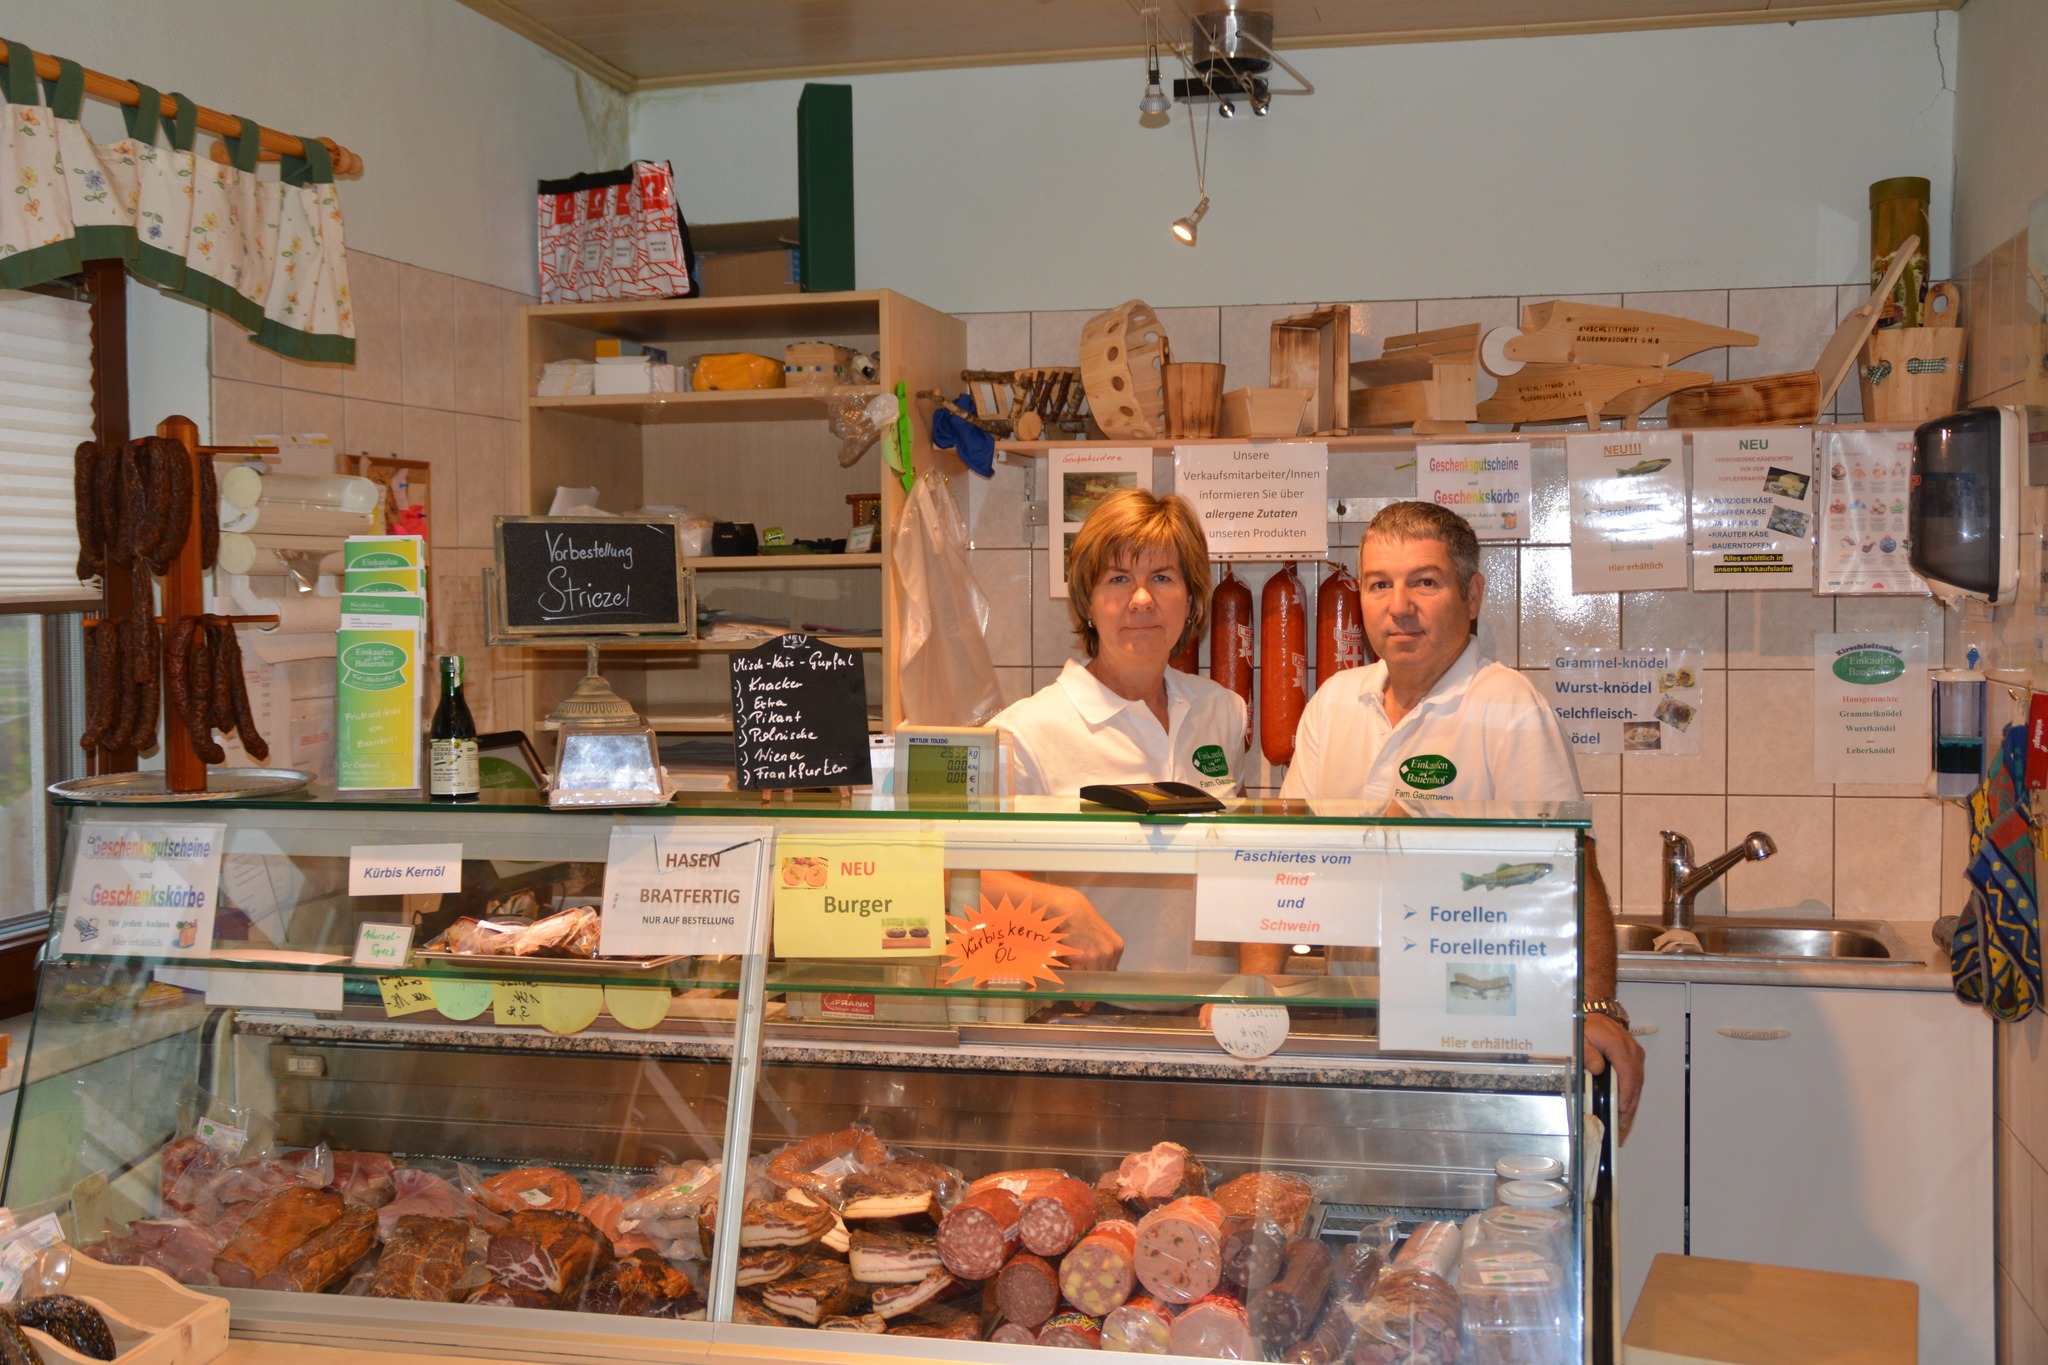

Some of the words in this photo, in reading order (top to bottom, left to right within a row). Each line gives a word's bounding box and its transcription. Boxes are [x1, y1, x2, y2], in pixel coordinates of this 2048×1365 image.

[1603, 443, 1642, 455] NEU!!!
[1739, 439, 1769, 450] NEU
[1233, 451, 1270, 460] Unsere
[1429, 456, 1519, 475] Geschenksgutscheine
[1183, 468, 1320, 481] Verkaufsmitarbeiter/Innen
[1199, 490, 1260, 500] informieren
[1262, 489, 1278, 499] Sie
[1280, 489, 1304, 499] über
[1434, 488, 1520, 505] Geschenkskörbe
[1205, 509, 1254, 520] allergene
[1257, 509, 1298, 519] Zutaten
[1209, 529, 1250, 538] unseren
[1253, 528, 1307, 538] Produkten
[545, 530, 633, 569] Vorbestellung
[1609, 564, 1625, 572] Hier
[1626, 562, 1664, 571] erhältlich
[538, 566, 630, 613] Striezel
[356, 648, 394, 656] Einkaufen
[355, 660, 395, 668] Bauernhof
[1555, 657, 1668, 669] Grammel-knödel
[1849, 656, 1895, 665] Einkaufen
[749, 677, 803, 692] Knacker
[1555, 681, 1652, 694] Wurst-knödel
[749, 710, 801, 724] Pikant
[1555, 707, 1638, 719] Selchfleisch-
[1839, 710, 1902, 718] Grammelknödel
[1570, 733, 1600, 744] ödel
[968, 749, 978, 759] kg
[754, 759, 847, 780] Frankfurter
[1411, 759, 1448, 770] Einkaufen
[1200, 780, 1216, 788] Fam.
[1407, 773, 1448, 785] Bauernhof
[1395, 789, 1411, 798] Fam.
[92, 836, 210, 863] Geschenksgutscheine
[666, 853, 721, 868] HASEN
[1234, 850, 1317, 864] Faschiertes
[1321, 855, 1352, 864] vom
[139, 871, 152, 879] und
[363, 867, 402, 879] Kürbis
[405, 865, 445, 878] Kernöl
[840, 861, 875, 877] NEU
[1275, 873, 1309, 886] Rind
[91, 883, 205, 908] Geschenkskörbe
[639, 888, 740, 904] BRATFERTIG
[824, 895, 893, 917] Burger
[1277, 897, 1305, 909] und
[642, 916, 661, 925] NUR
[662, 916, 680, 925] AUF
[682, 916, 735, 925] BESTELLUNG
[1430, 906, 1507, 923] Forellen
[121, 920, 143, 929] jeden
[1260, 918, 1321, 932] Schwein
[1430, 938, 1547, 956] Forellenfilet
[835, 999, 869, 1008] FRANK
[1441, 1036, 1468, 1049] Hier
[1472, 1037, 1533, 1050] erhältlich
